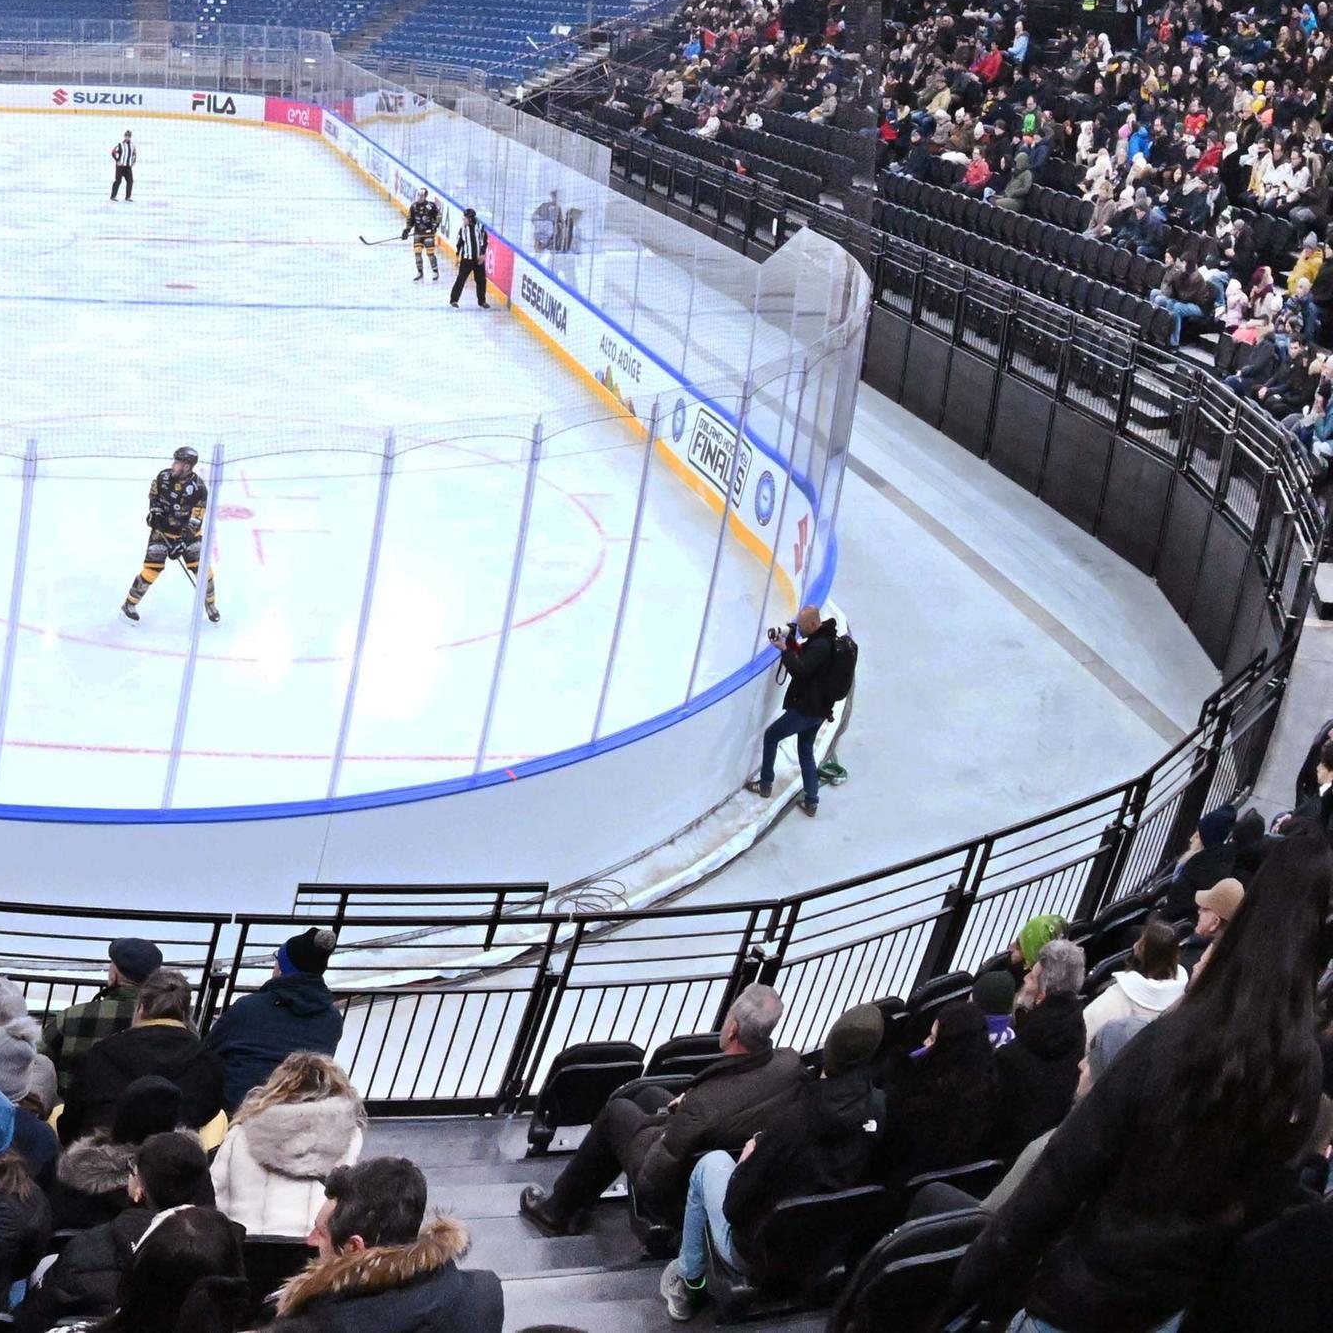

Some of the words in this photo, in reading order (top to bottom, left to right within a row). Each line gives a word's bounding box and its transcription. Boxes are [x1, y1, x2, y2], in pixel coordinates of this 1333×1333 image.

[73, 92, 143, 105] SUZUKI
[192, 93, 236, 115] FILA
[288, 107, 310, 127] enel
[521, 274, 568, 336] ESSELUNGA
[692, 430, 746, 497] FINALS
